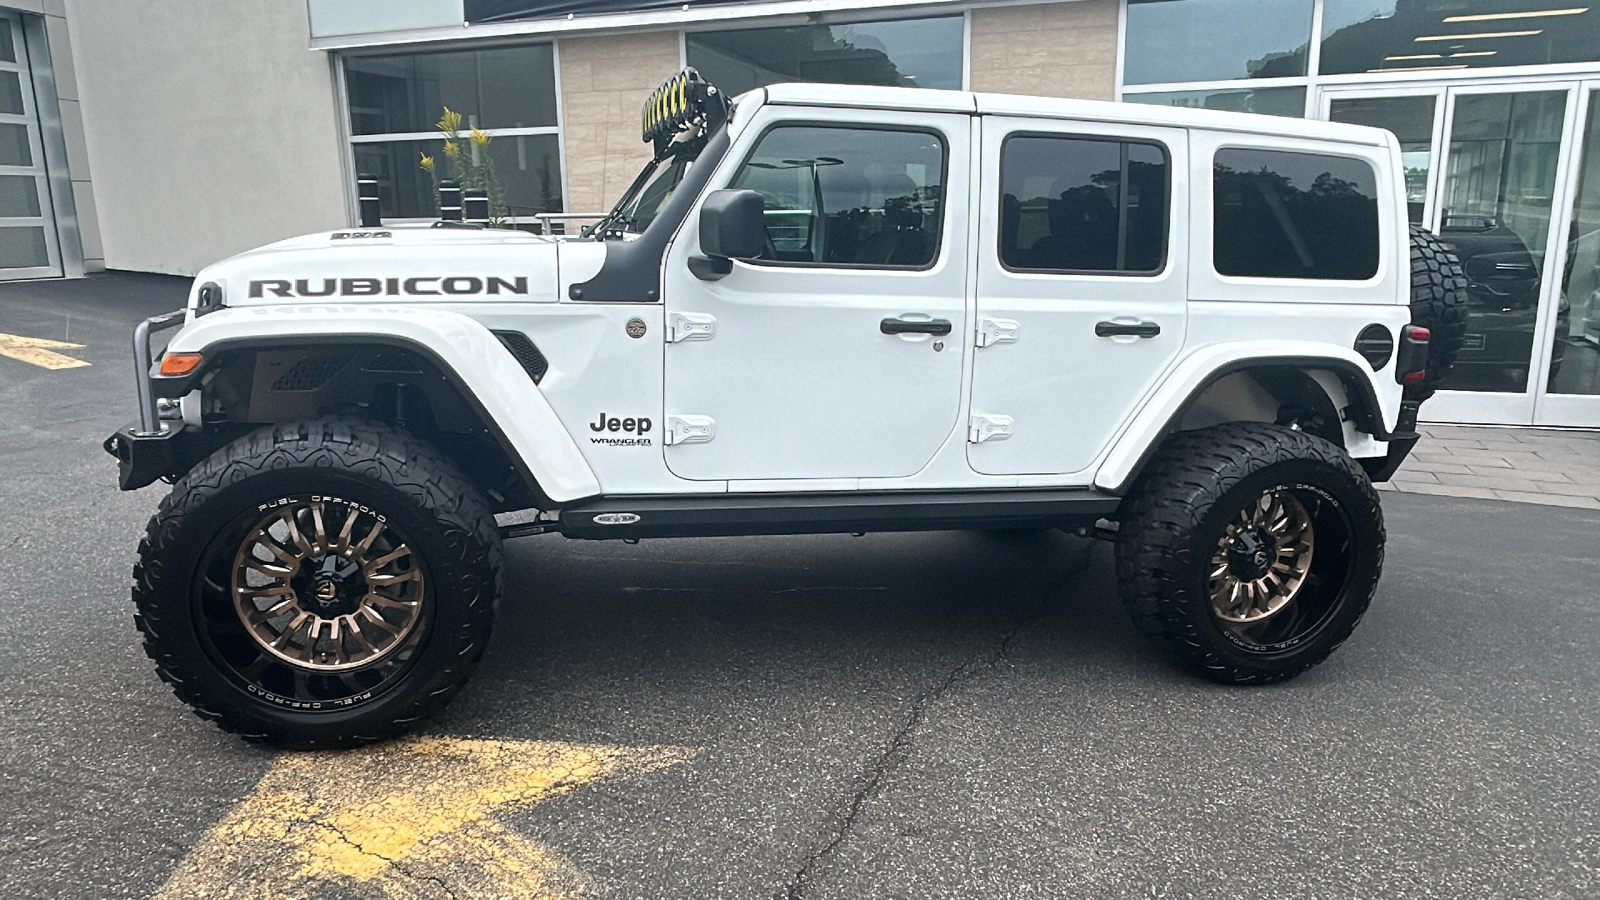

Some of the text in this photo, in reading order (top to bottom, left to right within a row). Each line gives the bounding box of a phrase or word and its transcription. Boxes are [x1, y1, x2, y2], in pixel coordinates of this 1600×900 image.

[248, 277, 529, 298] RUBICON
[590, 412, 652, 435] Jeep
[258, 495, 387, 523] FUEL OFF-ROAD
